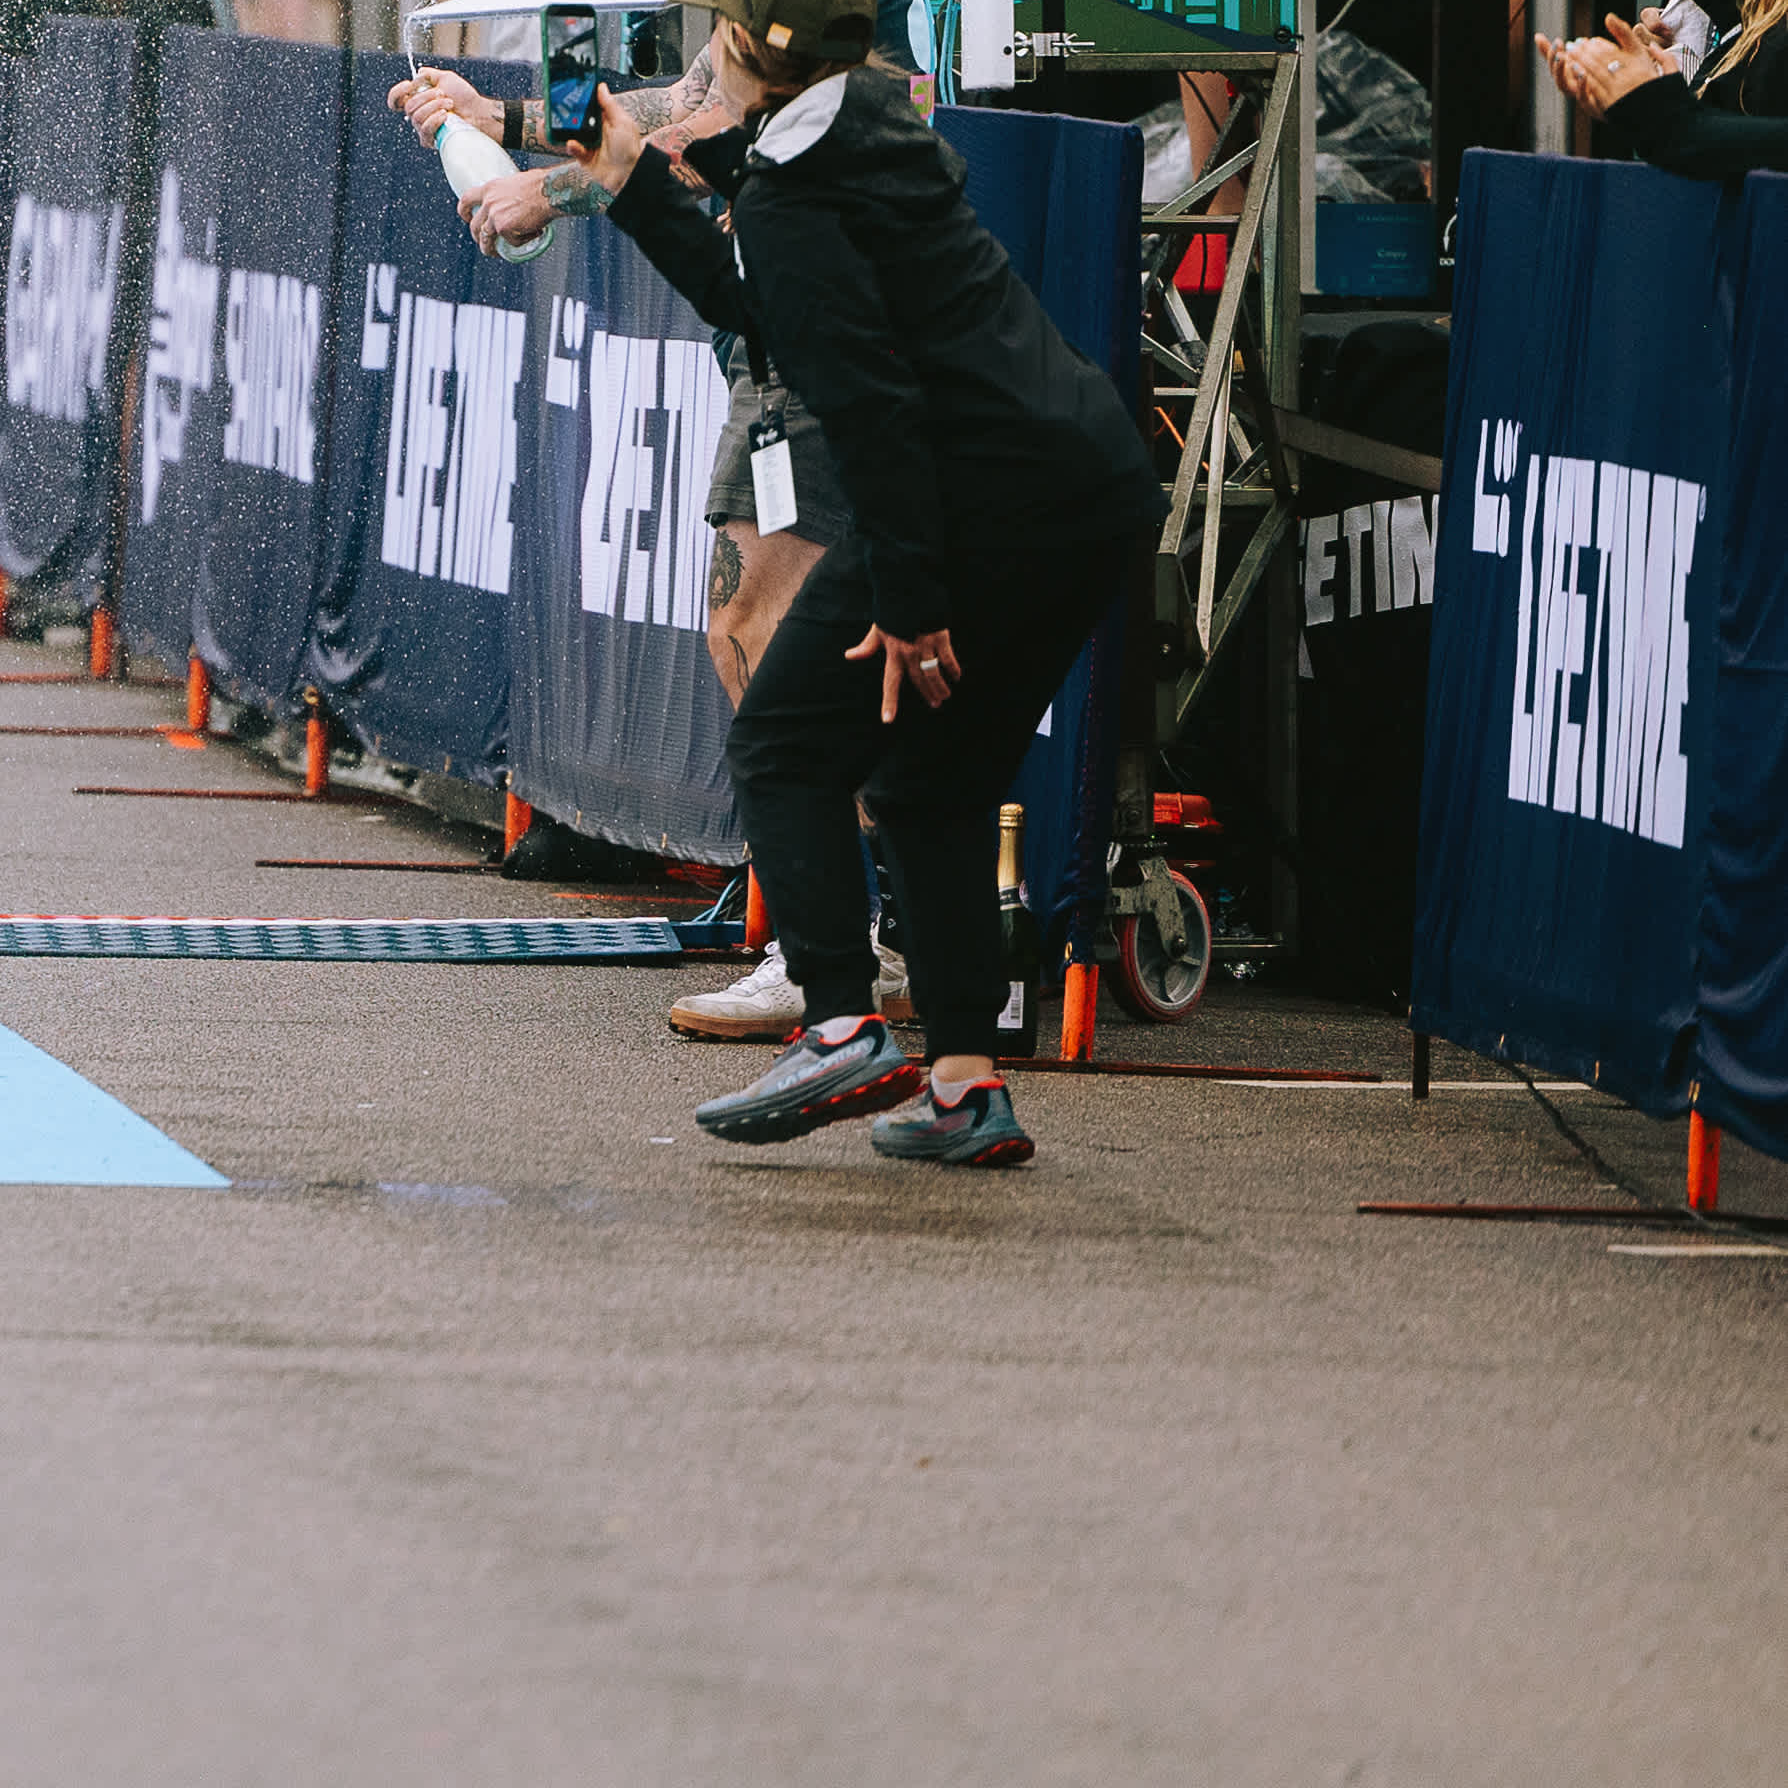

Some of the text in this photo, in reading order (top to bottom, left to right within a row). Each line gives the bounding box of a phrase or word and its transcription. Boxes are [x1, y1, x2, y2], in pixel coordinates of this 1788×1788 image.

[380, 291, 456, 580] LIFE
[580, 330, 660, 624] LIFE
[1507, 454, 1701, 851] LIFE TIME
